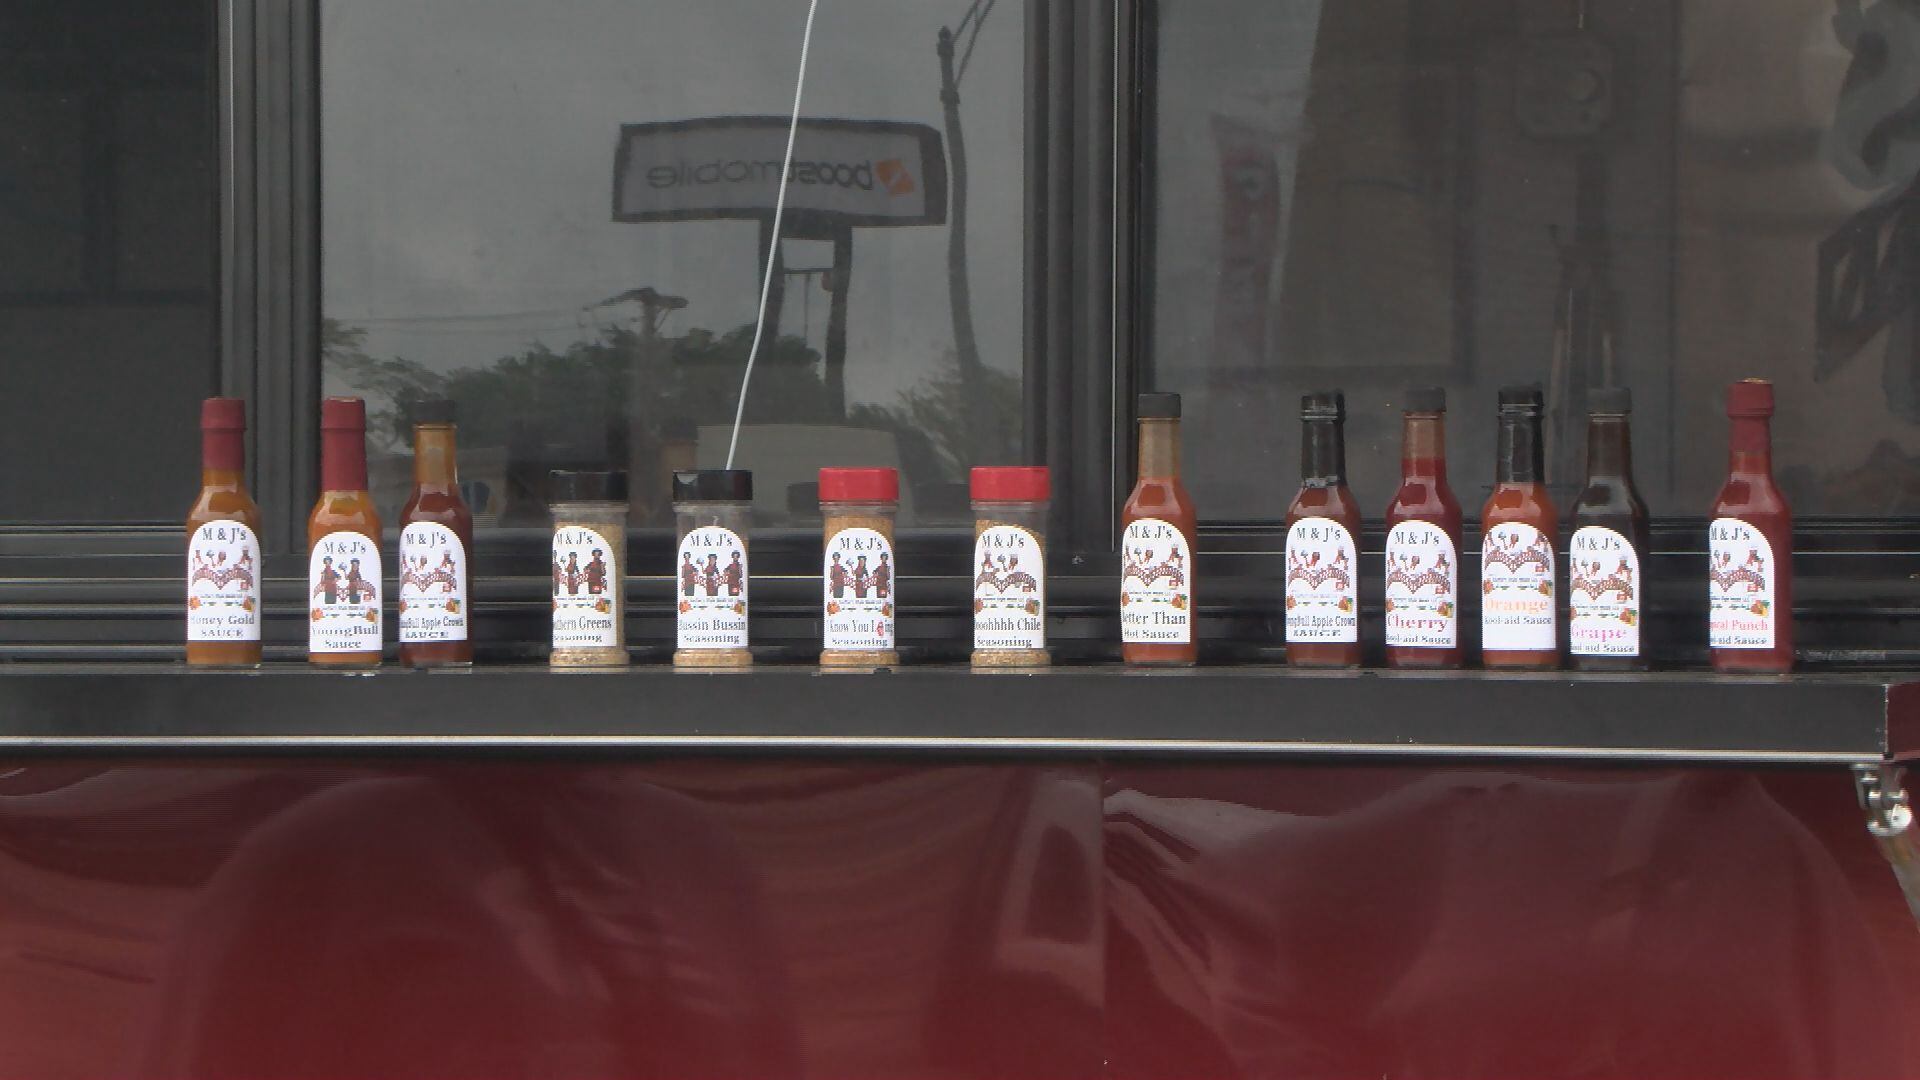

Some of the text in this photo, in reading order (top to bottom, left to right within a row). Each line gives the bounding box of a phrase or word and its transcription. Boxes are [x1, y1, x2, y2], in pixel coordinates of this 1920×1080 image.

[203, 527, 247, 544] M & J's
[556, 531, 593, 545] M & J's
[1129, 525, 1173, 539] M & J's
[1296, 525, 1341, 542] M & J's
[1395, 531, 1440, 545] M & J's
[1710, 525, 1750, 541] M & J's
[406, 531, 447, 548] M & J's
[690, 533, 733, 547] M & J's
[840, 537, 883, 550] M & J's
[982, 533, 1025, 548] M & J's
[1576, 536, 1621, 551] M & J's
[325, 541, 366, 553] M & J's
[1485, 599, 1549, 614] Orange
[228, 614, 255, 625] Gold
[578, 616, 612, 631] Greens
[713, 618, 746, 631] Bussin
[1017, 618, 1041, 631] Chile
[1152, 611, 1186, 625] Than
[1387, 615, 1447, 632] Cherry
[1522, 616, 1552, 625] Sauce
[851, 619, 869, 632] You
[1732, 619, 1768, 631] Punch
[201, 629, 244, 638] SAUCE
[683, 634, 740, 645] Seasoning
[1142, 630, 1179, 639] Sauce
[1421, 635, 1452, 645] Sauce
[1571, 624, 1627, 643] Grape
[977, 636, 1032, 648] Seasoning
[1734, 635, 1767, 646] Sauce
[1603, 644, 1635, 653] Sauce
